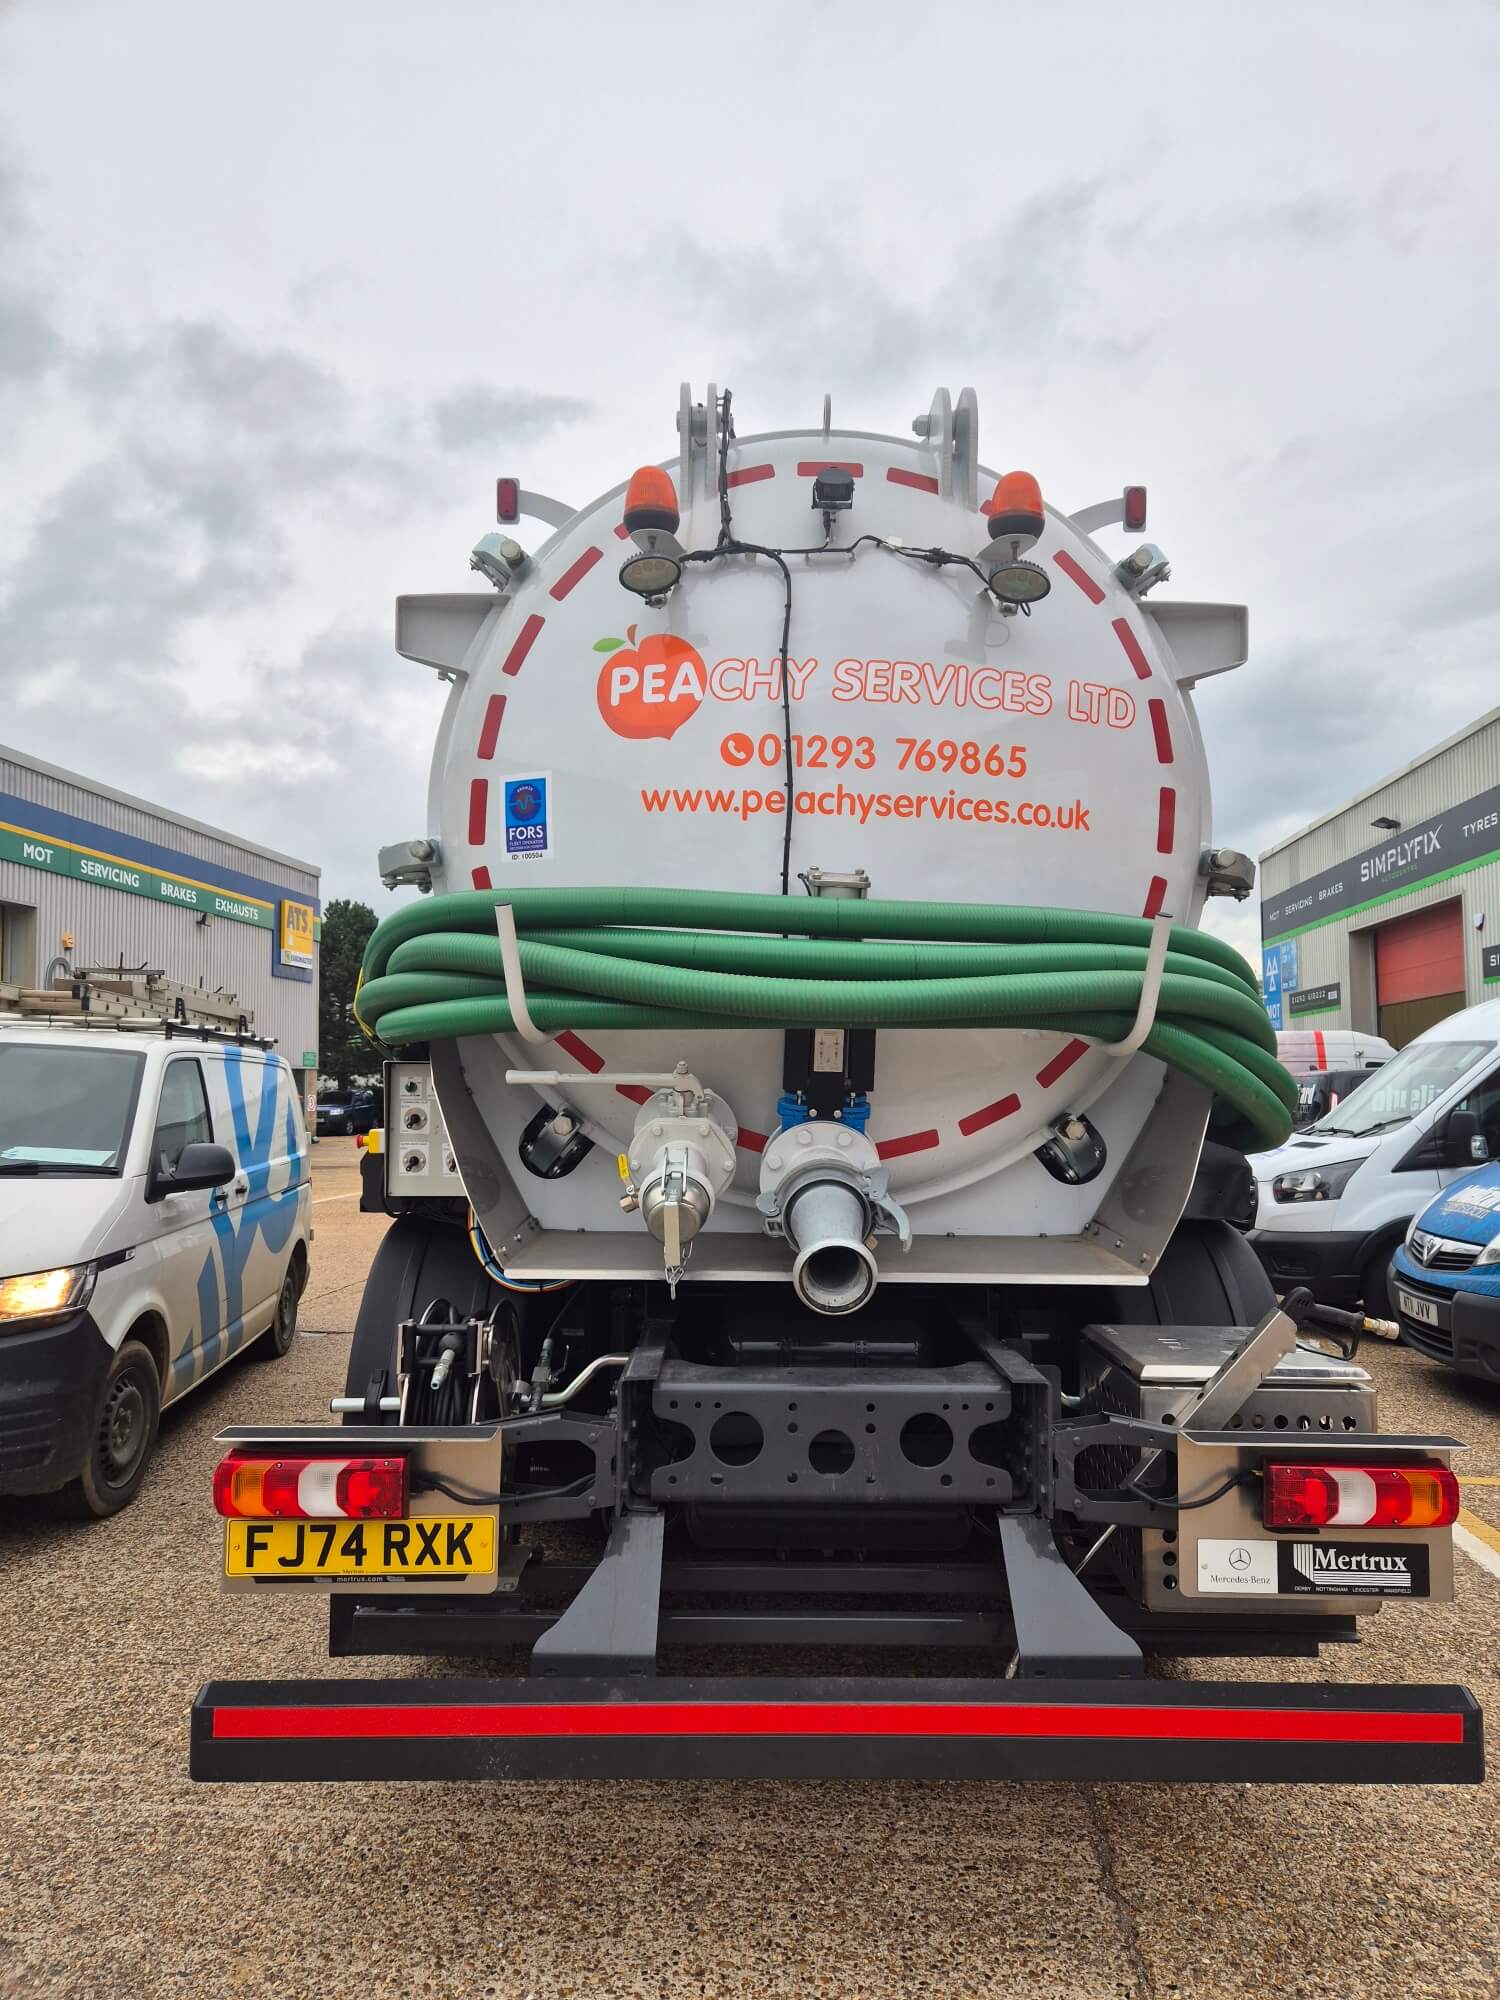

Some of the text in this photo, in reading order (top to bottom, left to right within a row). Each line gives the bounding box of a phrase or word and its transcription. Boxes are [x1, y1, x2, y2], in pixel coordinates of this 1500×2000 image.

[610, 657, 1136, 729] PEACHY SERVICES LTD
[758, 733, 1027, 778] 01293 769865
[641, 783, 1090, 832] www.peachyservices.co.uk
[509, 825, 544, 841] FORS
[1462, 812, 1499, 838] TYRES
[23, 842, 54, 864] MOT
[1360, 824, 1443, 882] SIMPLYFIX
[80, 859, 140, 887] SERVICING
[160, 882, 197, 904] BRAKES
[1284, 896, 1313, 915] SERVICING
[1318, 882, 1344, 901] BRAKES
[215, 897, 259, 920] EXHAUSTS
[286, 904, 308, 934] ATS
[246, 1523, 473, 1568] FJ74 RXK
[1313, 1548, 1408, 1572] Mertrux
[1210, 1575, 1271, 1585] Mercedes-Benz
